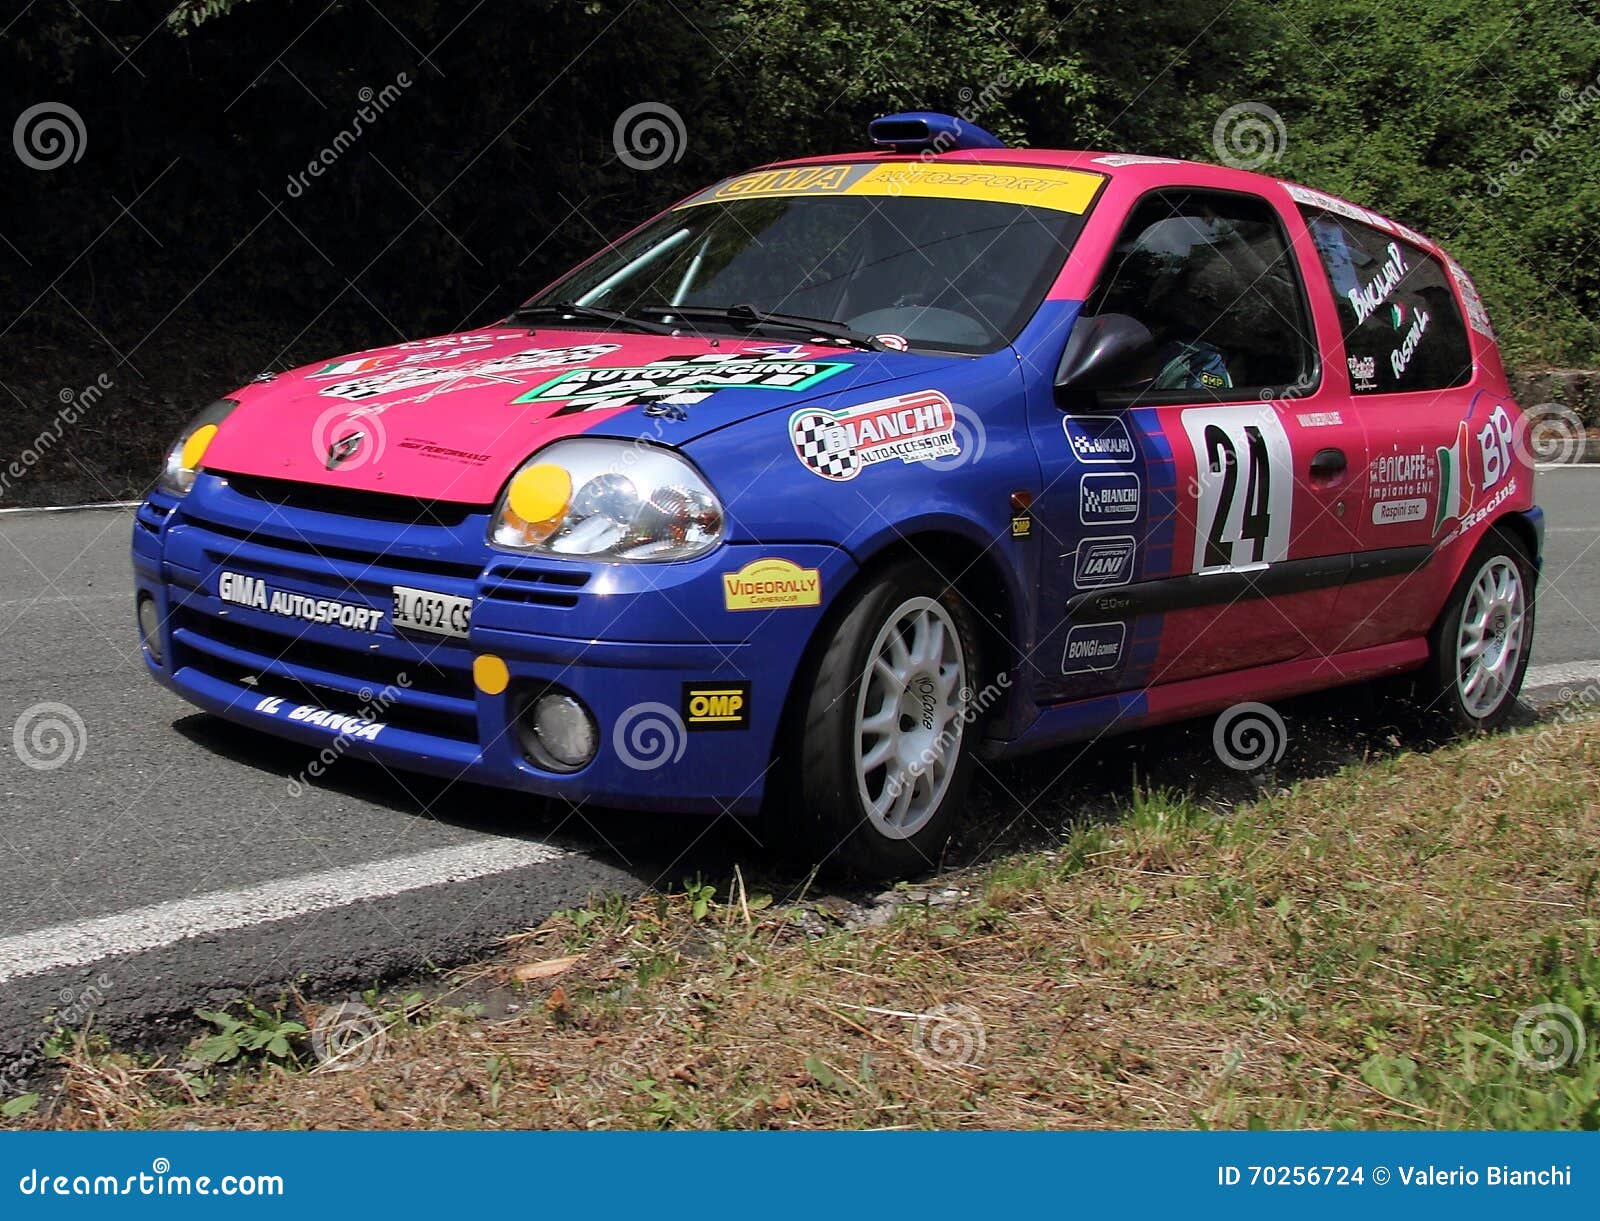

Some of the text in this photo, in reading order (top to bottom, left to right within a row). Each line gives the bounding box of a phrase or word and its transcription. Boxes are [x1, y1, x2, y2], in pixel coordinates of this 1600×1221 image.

[715, 166, 1069, 197] GIMA AUTOSPORT
[562, 363, 818, 383] AUTOFFICINA
[1202, 374, 1224, 387] OMP
[539, 374, 804, 397] IANI
[823, 403, 945, 454] BIANCHI
[861, 433, 953, 463] AUTOACCESSORI
[1477, 405, 1513, 491] BP
[1101, 488, 1138, 503] BIANCHI
[1203, 424, 1270, 568] 24
[1369, 481, 1432, 500] Impianto ENI
[1381, 502, 1406, 520] Raspini
[1459, 477, 1517, 535] Racing
[1012, 520, 1031, 534] OMP
[1084, 556, 1124, 575] IANI
[726, 578, 817, 597] VIDEORALLY
[218, 571, 385, 632] GIMA AUTOSPORT
[414, 596, 444, 628] 052
[451, 603, 470, 633] CS
[1068, 639, 1098, 659] BONGI
[689, 696, 743, 716] OMP
[254, 696, 388, 740] IL BANCA
